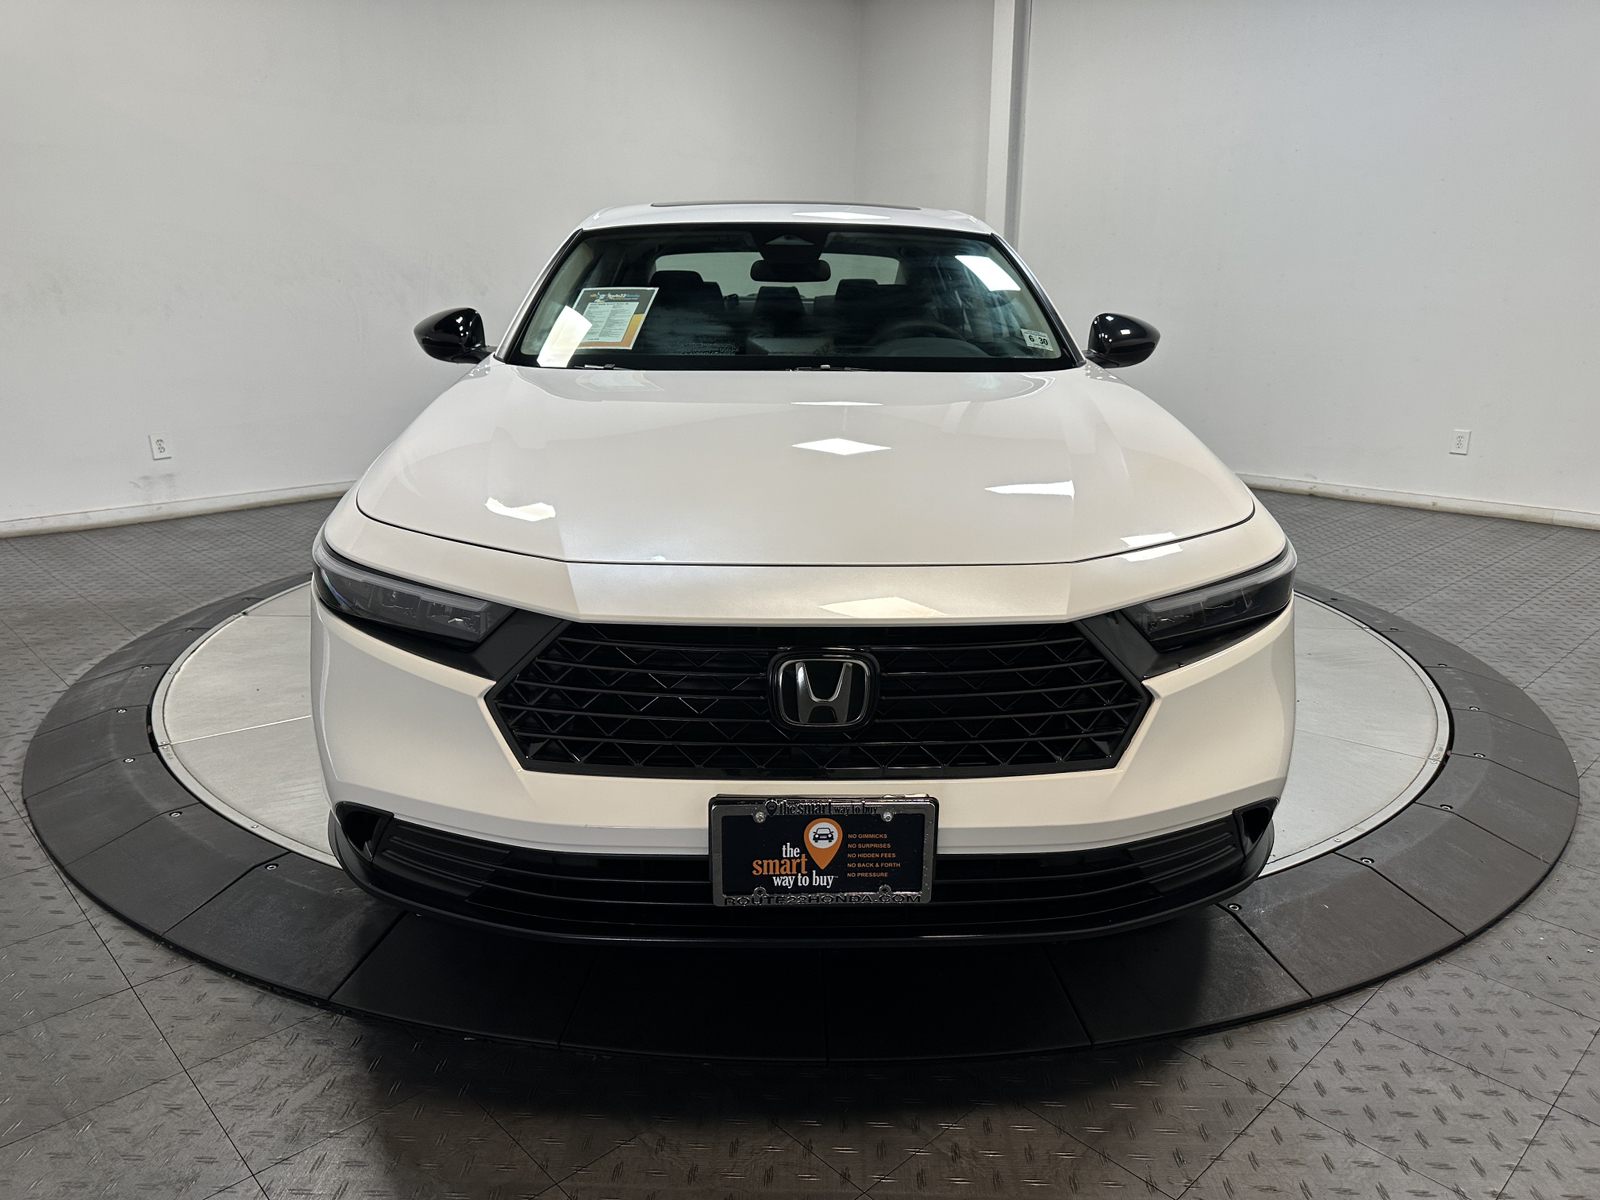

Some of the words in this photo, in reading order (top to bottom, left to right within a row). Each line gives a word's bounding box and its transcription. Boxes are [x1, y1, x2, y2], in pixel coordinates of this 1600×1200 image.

[1038, 337, 1048, 345] 30
[780, 799, 796, 815] the
[797, 799, 832, 815] smart
[833, 804, 851, 816] way
[861, 800, 878, 816] buy
[782, 842, 800, 858] the
[752, 853, 808, 876] smart
[772, 875, 796, 889] way
[797, 872, 810, 887] to
[812, 869, 834, 889] buy
